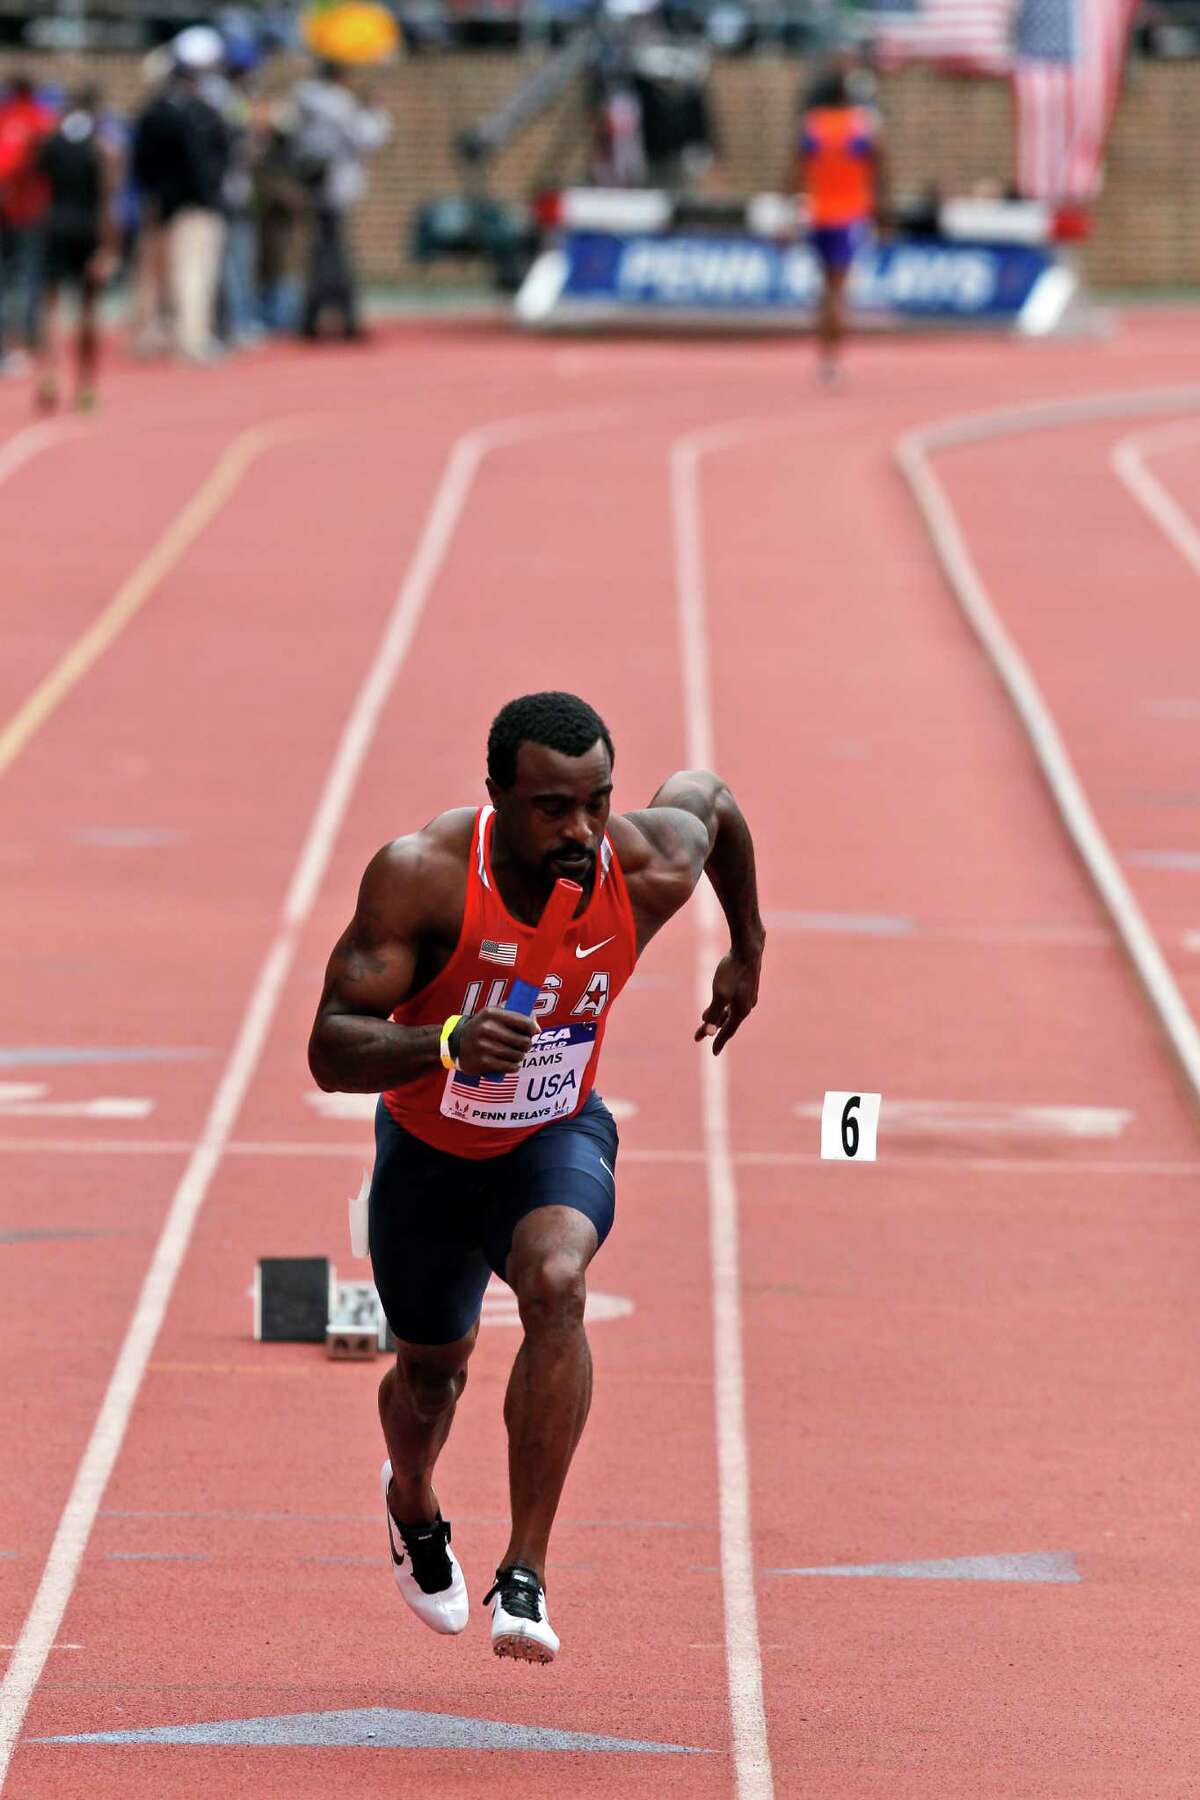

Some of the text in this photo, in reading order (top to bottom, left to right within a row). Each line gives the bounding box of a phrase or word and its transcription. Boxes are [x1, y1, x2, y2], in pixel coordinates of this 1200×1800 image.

[784, 246, 994, 310] RLAYS
[461, 971, 610, 1017] USA
[522, 1052, 563, 1068] IAMS
[526, 1069, 576, 1101] USA
[472, 1109, 507, 1121] PENN
[510, 1107, 551, 1121] RELAYS
[841, 1095, 861, 1158] 6
